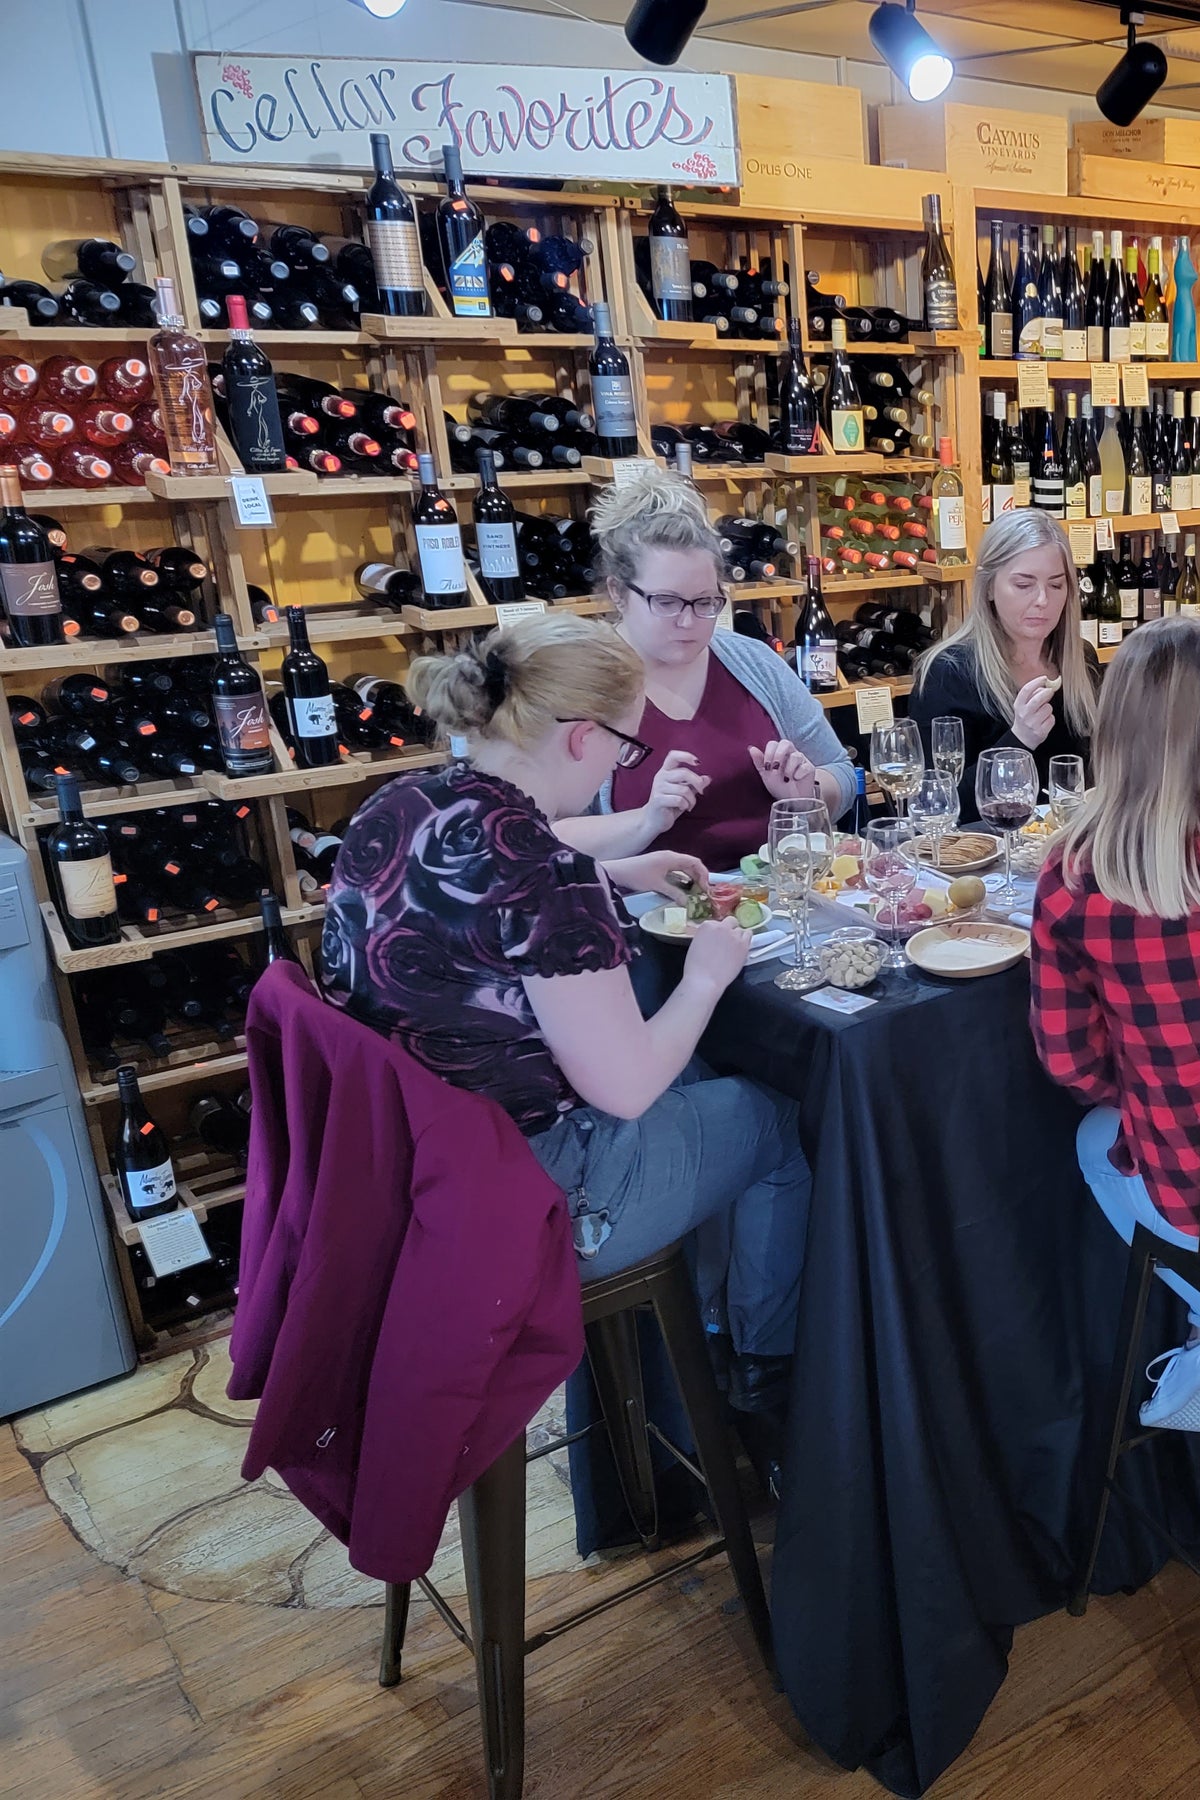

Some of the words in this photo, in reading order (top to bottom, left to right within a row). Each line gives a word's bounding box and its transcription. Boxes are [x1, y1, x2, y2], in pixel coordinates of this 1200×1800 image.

[211, 62, 397, 153] Cellar
[403, 73, 713, 165] Favorites
[976, 121, 1040, 149] CAYMUS
[980, 145, 1037, 160] VINEYARDS
[243, 502, 262, 510] LOCAL
[16, 572, 54, 606] Josh
[229, 705, 264, 739] Josh
